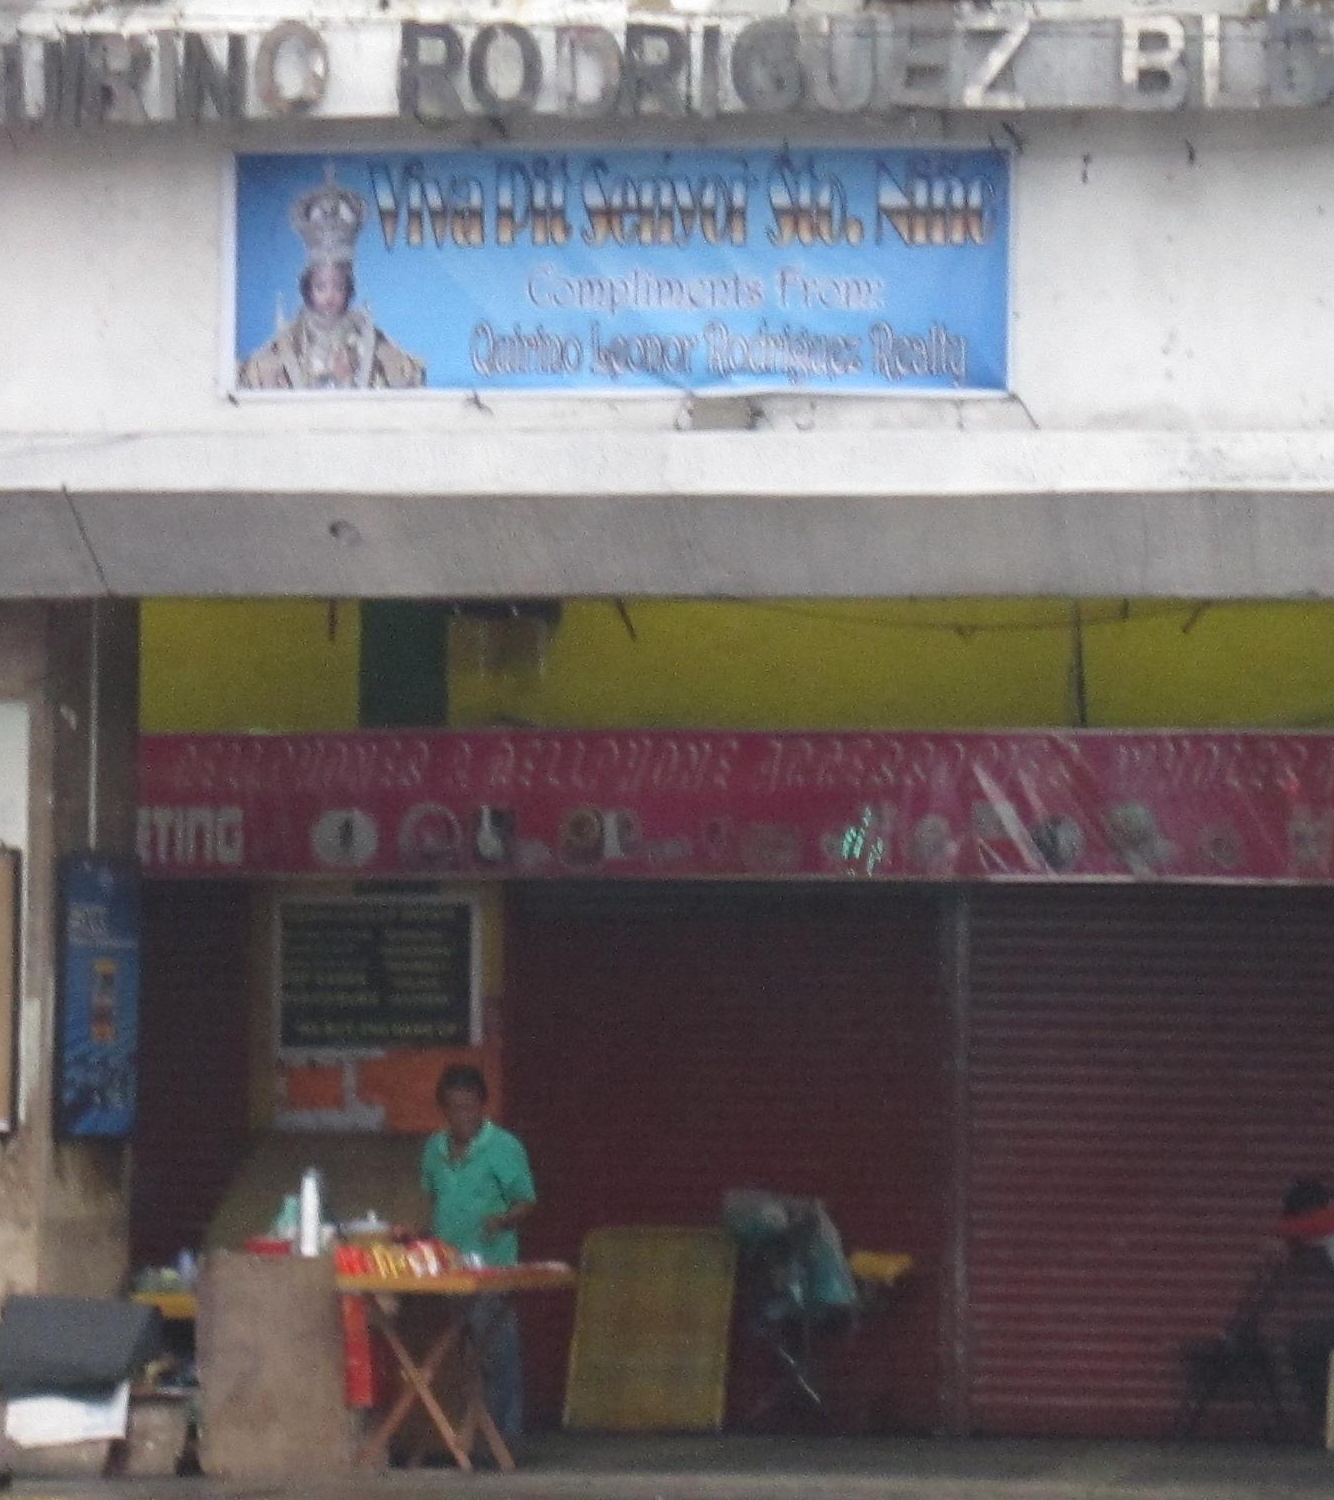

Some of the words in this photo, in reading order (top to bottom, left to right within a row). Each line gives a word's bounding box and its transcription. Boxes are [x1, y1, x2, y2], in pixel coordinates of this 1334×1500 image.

[398, 14, 1030, 117] RODRIGUEZ
[367, 154, 485, 252] Viva
[524, 264, 764, 316] Compliments
